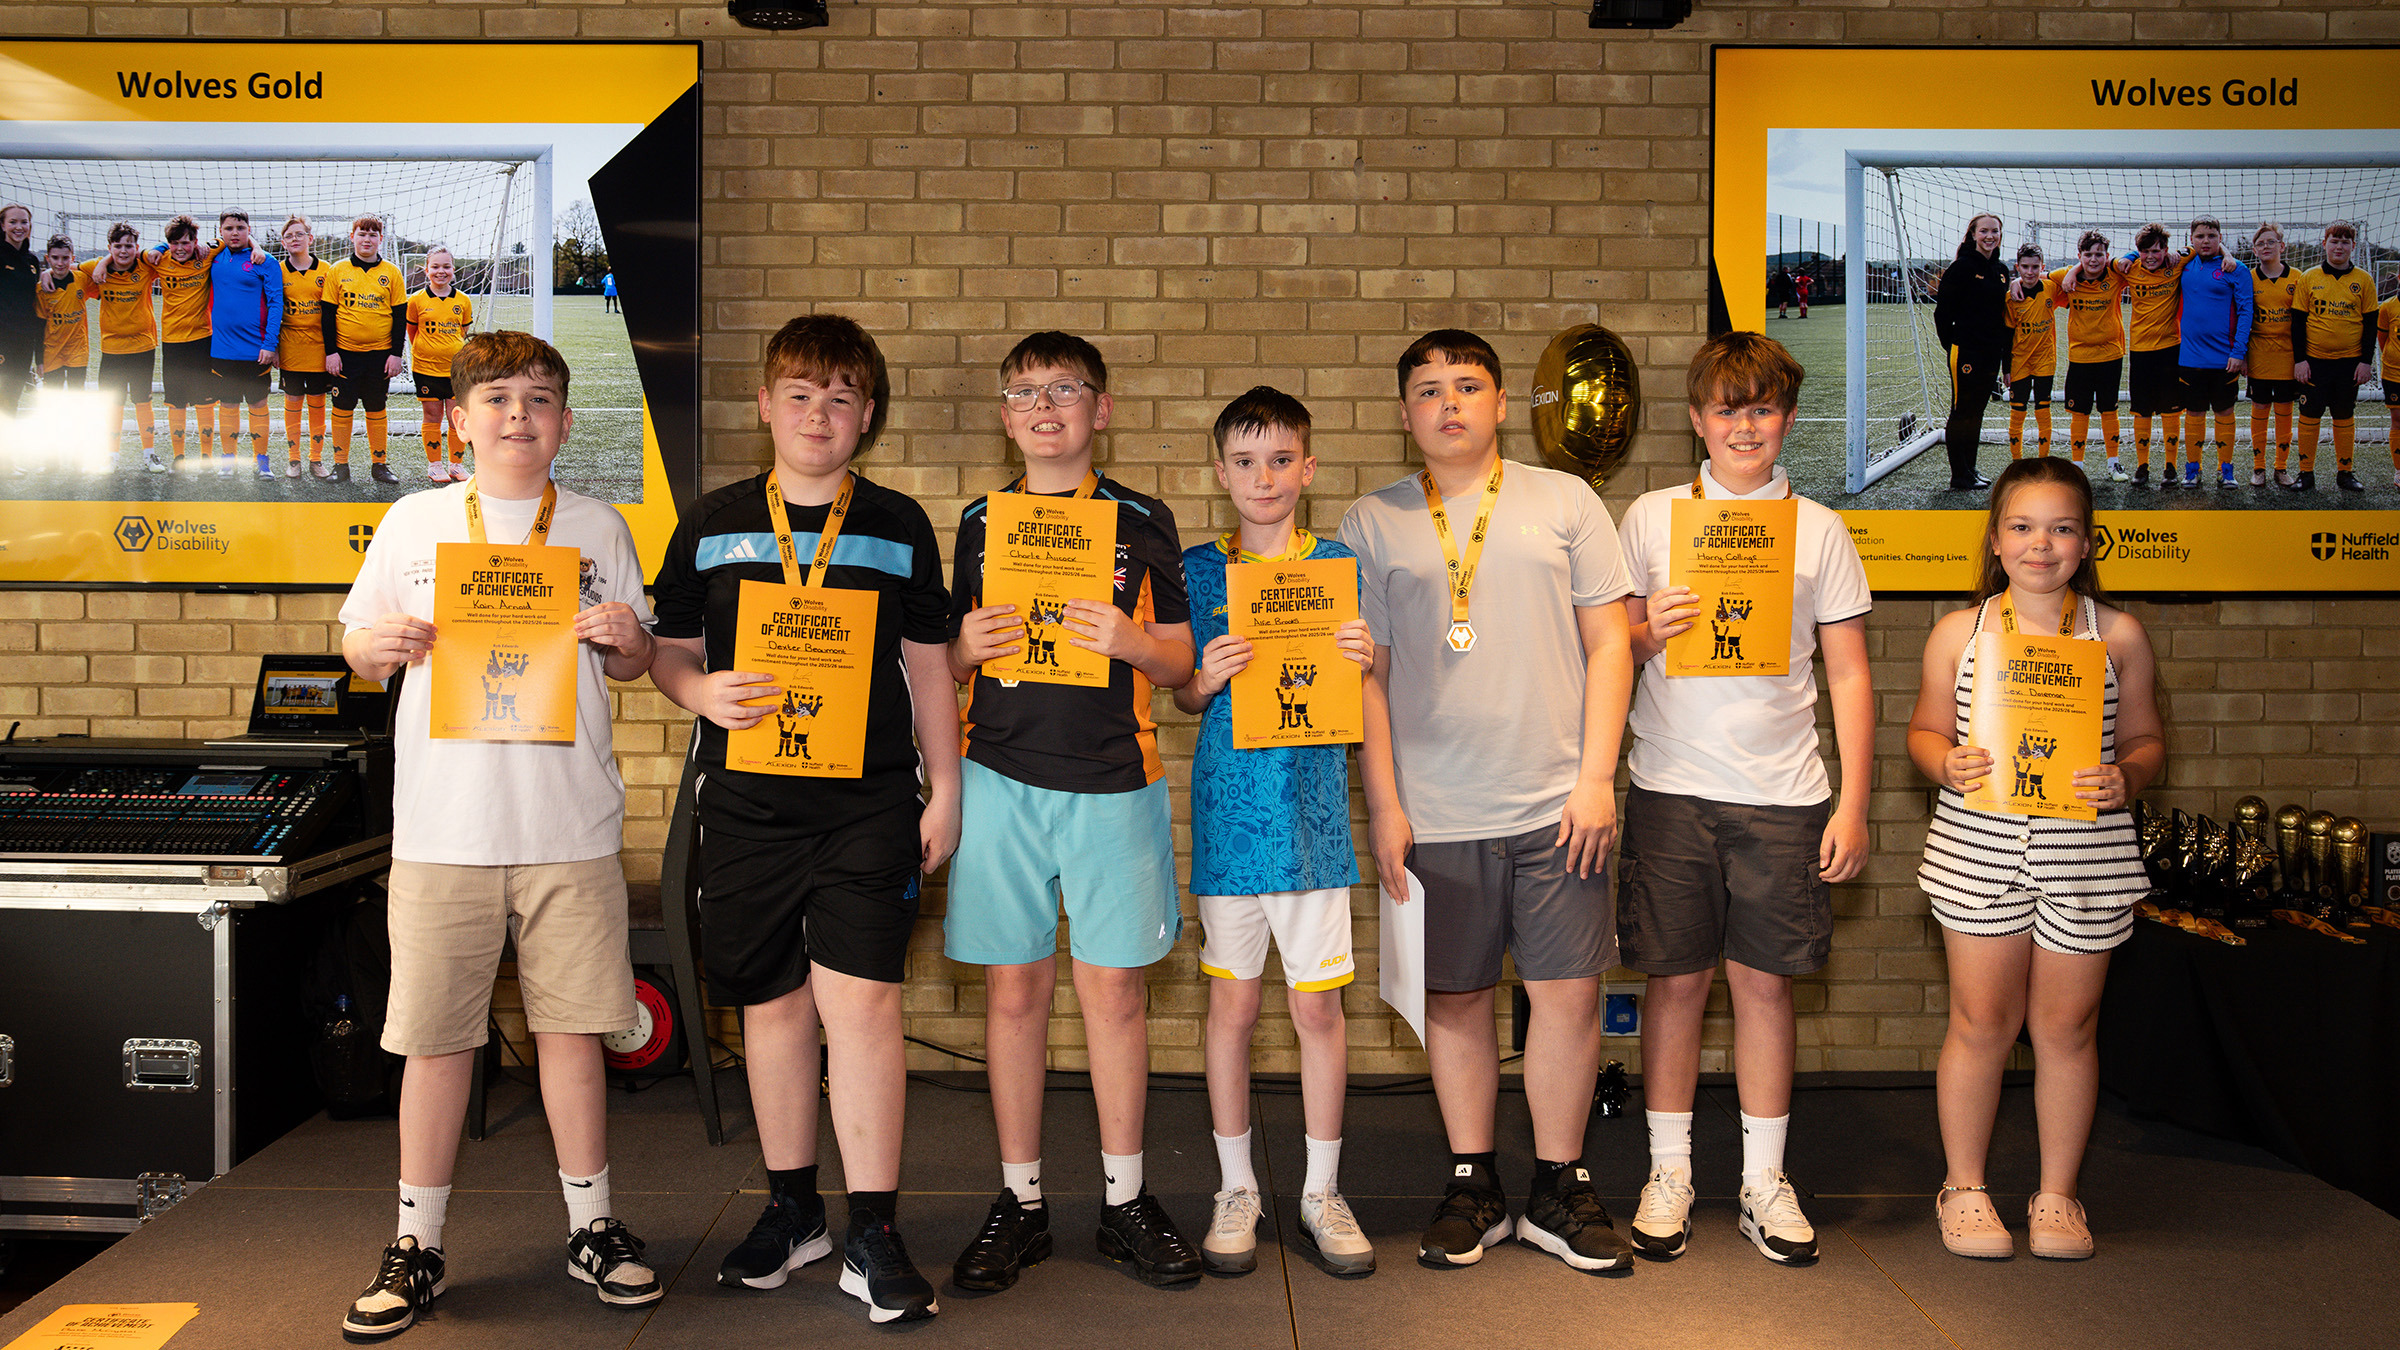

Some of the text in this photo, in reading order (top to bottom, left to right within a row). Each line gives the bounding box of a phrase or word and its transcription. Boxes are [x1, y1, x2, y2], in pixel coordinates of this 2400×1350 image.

[117, 70, 322, 99] Wolves Gold
[2091, 78, 2297, 106] Wolves Gold
[1531, 389, 1559, 408] LEXION
[157, 520, 216, 534] Wolves
[1018, 521, 1082, 537] CERTIFICATE
[1704, 525, 1766, 536] CERTIFICATE
[1007, 532, 1091, 550] OF ACHIEVEMENT
[1694, 537, 1775, 548] OF ACHIEVEMENT
[2118, 528, 2178, 542] Wolves
[2342, 532, 2400, 546] Nuffield
[158, 536, 230, 554] Disability
[1696, 552, 1723, 562] Harry
[1905, 554, 1944, 562] Changing
[2118, 545, 2190, 562] Disability
[2342, 547, 2389, 560] Health
[472, 570, 543, 584] CERTIFICATE
[461, 583, 553, 597] OF ACHIEVEMENT
[1260, 586, 1324, 600] CERTIFICATE
[1251, 598, 1334, 613] OF ACHIEVEMENT
[772, 611, 841, 628] CERTIFICATE
[761, 623, 850, 642] OF ACHIEVEMENT
[768, 640, 846, 655] Dexter Beaumont
[2008, 659, 2073, 675] CERTIFICATE
[1997, 670, 2082, 688] OF ACHIEVEMENT
[1320, 952, 1348, 968] SUDU
